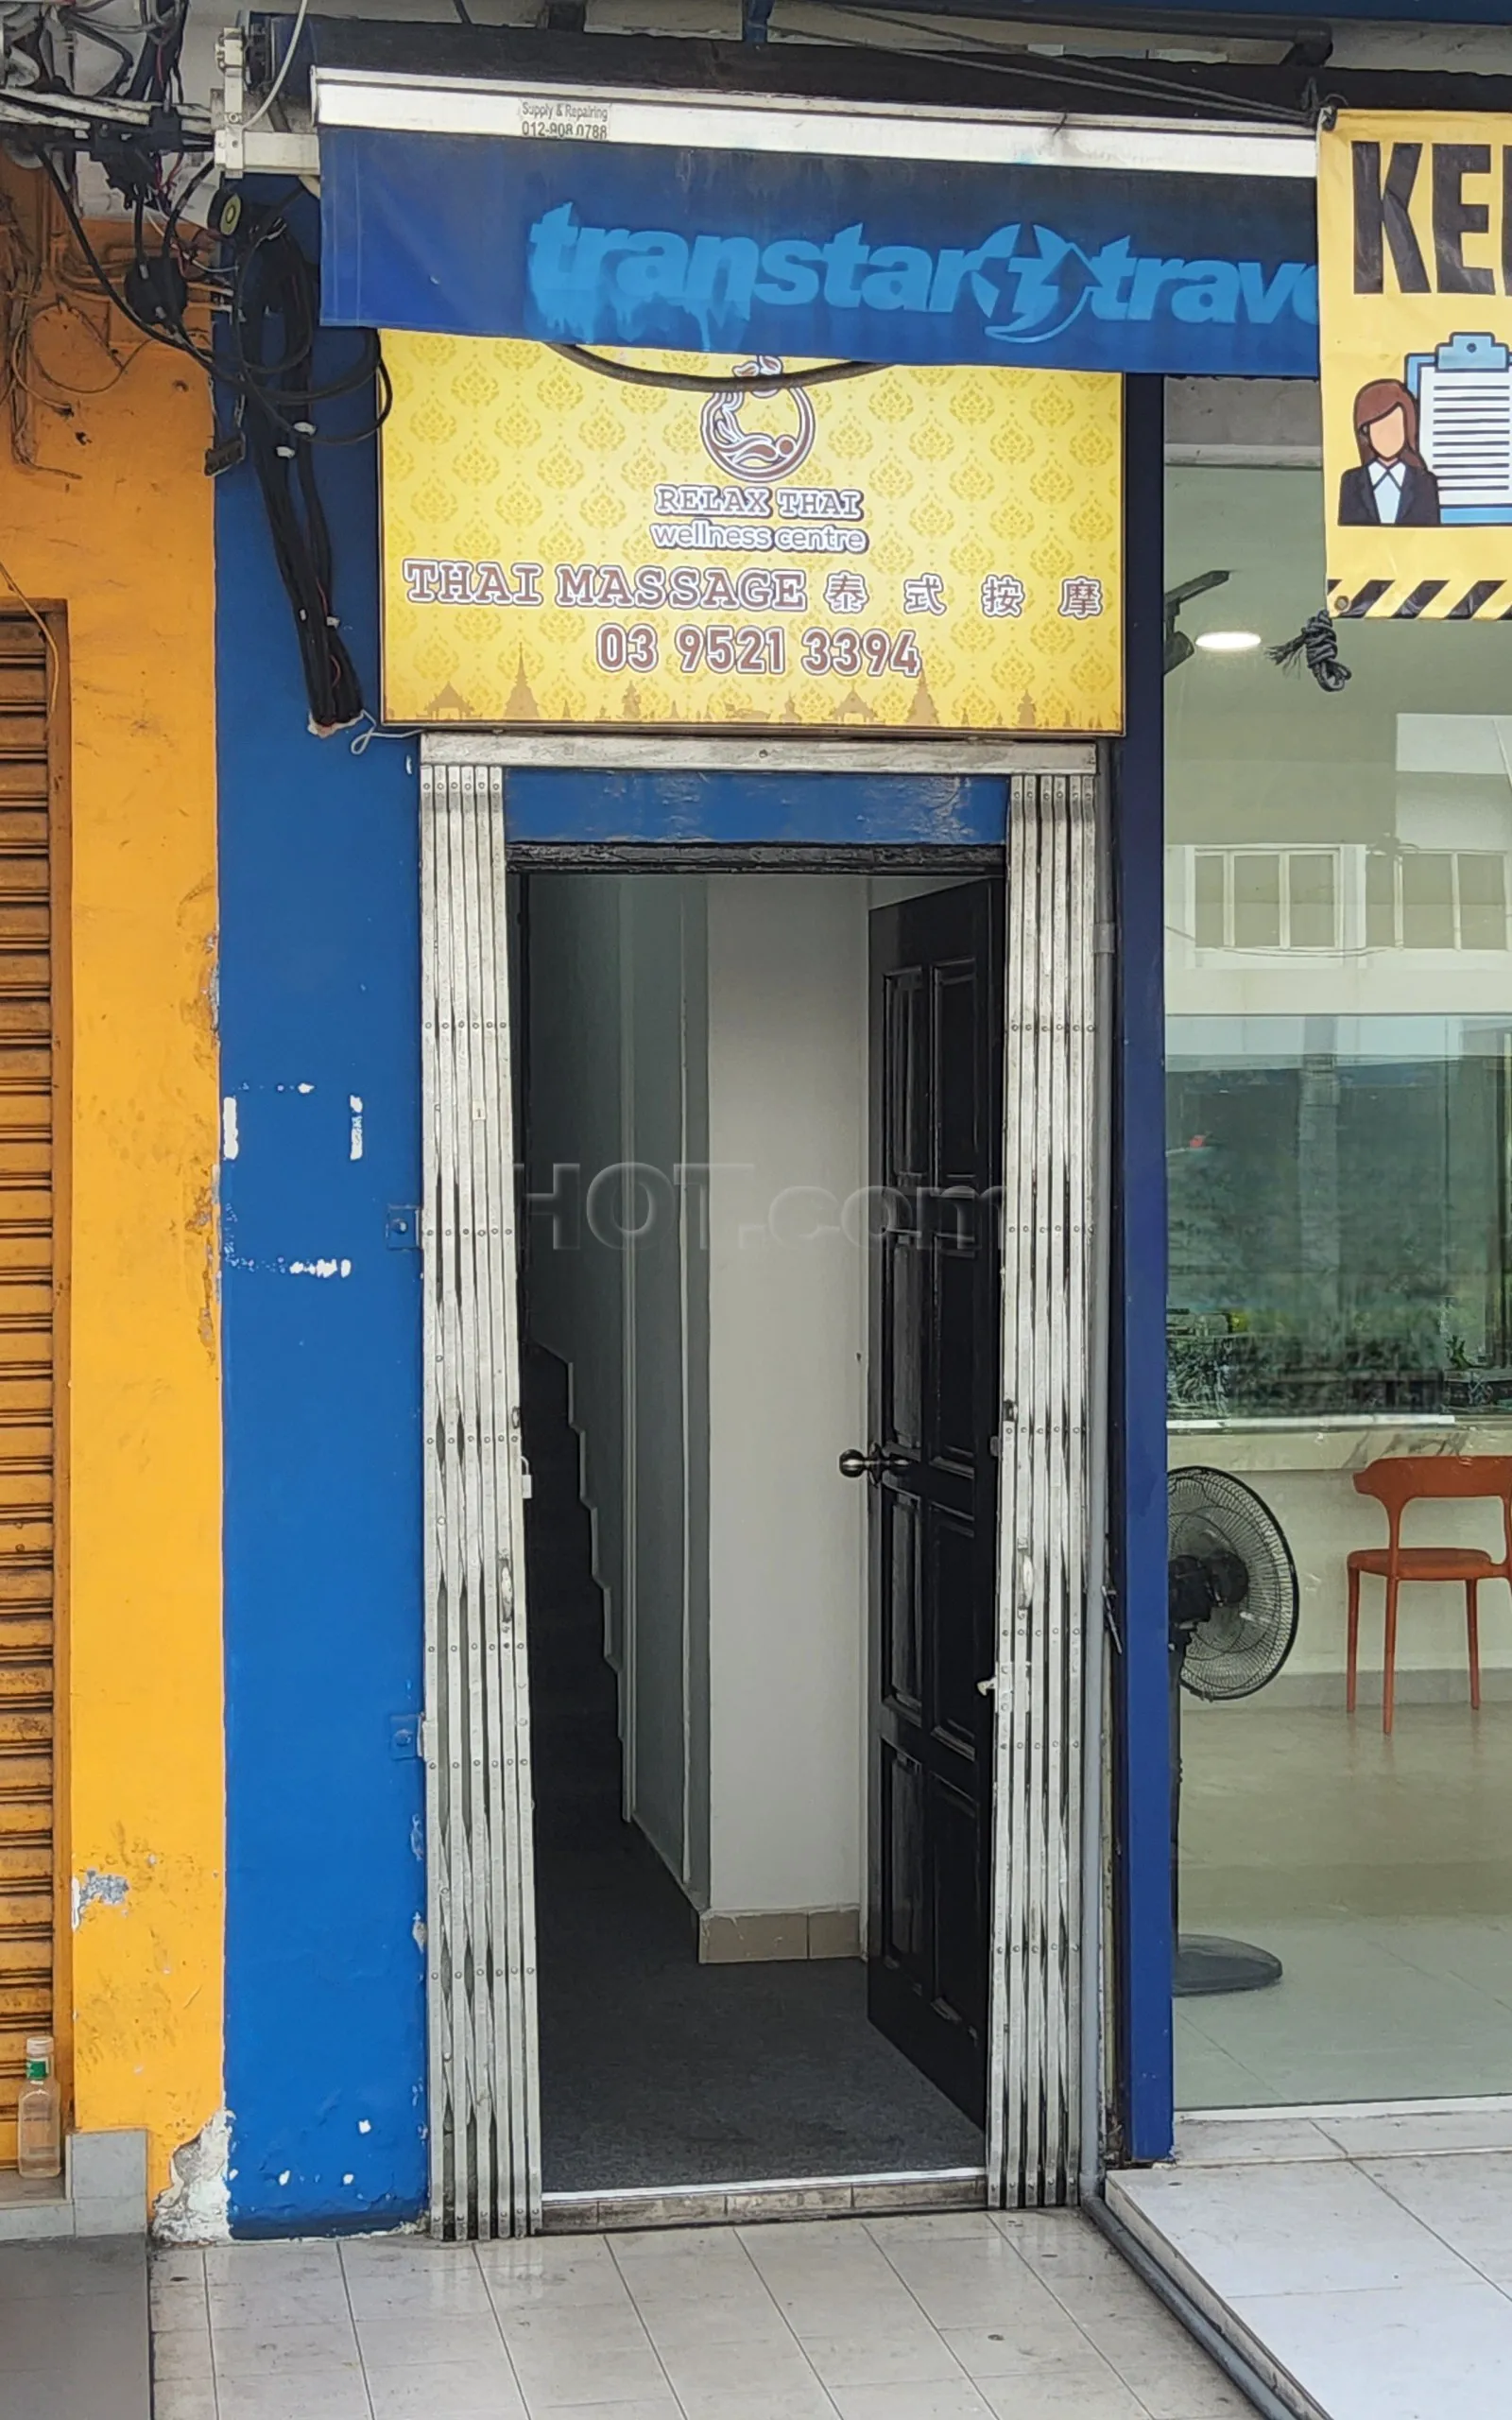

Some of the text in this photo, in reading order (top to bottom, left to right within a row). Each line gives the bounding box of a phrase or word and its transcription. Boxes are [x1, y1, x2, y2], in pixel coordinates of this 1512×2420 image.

[522, 101, 609, 122] Supply & Repairing
[1351, 140, 1512, 296] KE
[529, 201, 985, 314] transtar
[654, 484, 865, 521] RELAX THAI
[650, 518, 869, 554] wellness centre
[404, 560, 807, 612] THAI MASSAGE
[824, 571, 1103, 619] 泰式按摩
[595, 623, 922, 678] 03 9521 3394
